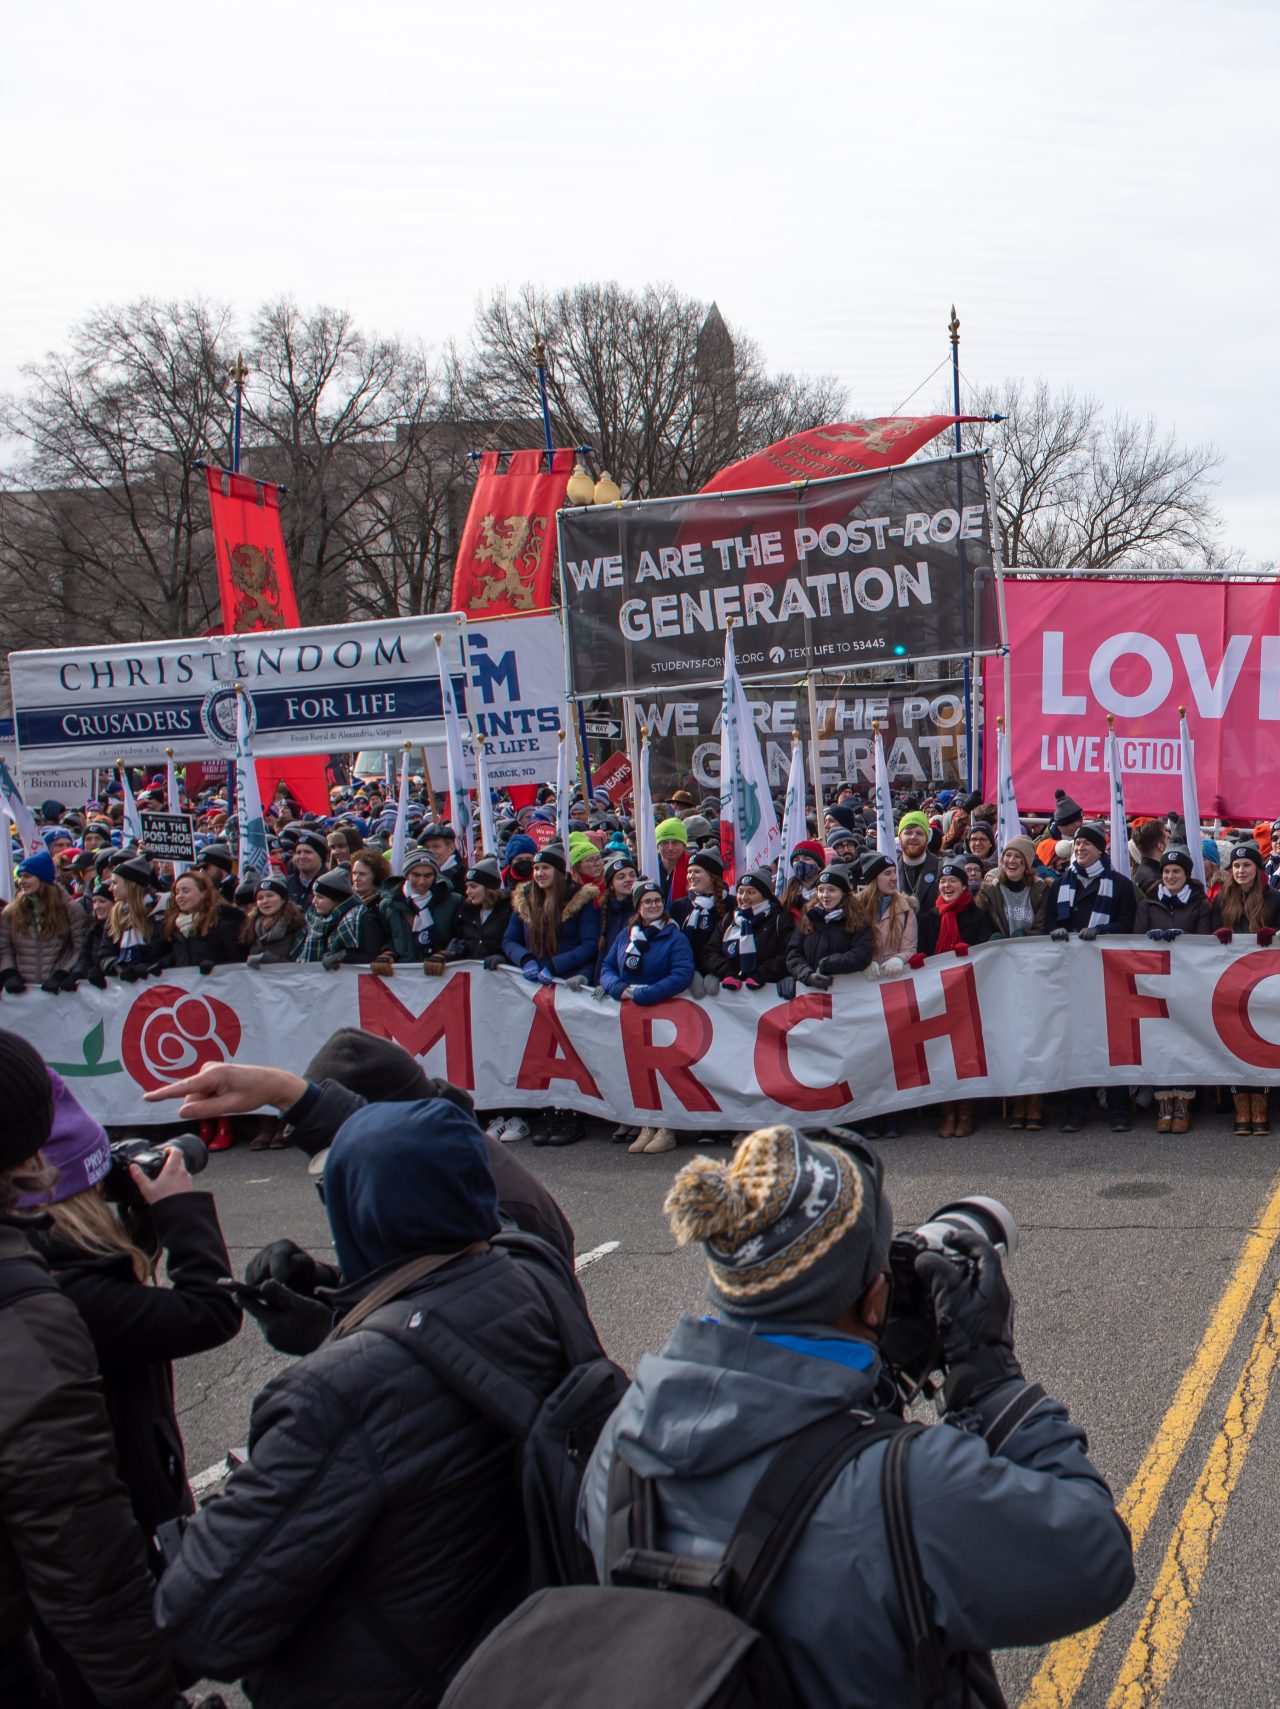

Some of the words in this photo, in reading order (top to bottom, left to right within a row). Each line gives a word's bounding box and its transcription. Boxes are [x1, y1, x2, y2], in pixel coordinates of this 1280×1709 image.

[567, 555, 624, 592] WE
[634, 543, 705, 584] ARE
[712, 531, 785, 572] THE
[794, 505, 986, 561] POST-ROE
[619, 562, 933, 642] GENERATION
[59, 635, 411, 691] CHRISTENDOM
[788, 648, 812, 659] TEXT
[814, 644, 835, 656] LIFE
[837, 642, 851, 654] TO
[853, 638, 886, 651] 53445
[62, 709, 192, 737] CRUSADERS
[285, 697, 341, 721] FOR
[344, 692, 397, 716] LIFE
[635, 703, 700, 737] WE
[816, 699, 889, 732] THE
[310, 732, 329, 742] Royal
[500, 738, 540, 754] LIFE
[1041, 735, 1100, 773] LIVE
[31, 777, 88, 788] Bismarck
[523, 768, 536, 776] ND
[143, 831, 192, 844] POST-ROE
[151, 821, 166, 831] AM
[169, 822, 188, 832] THE
[358, 961, 988, 1112] MARCH
